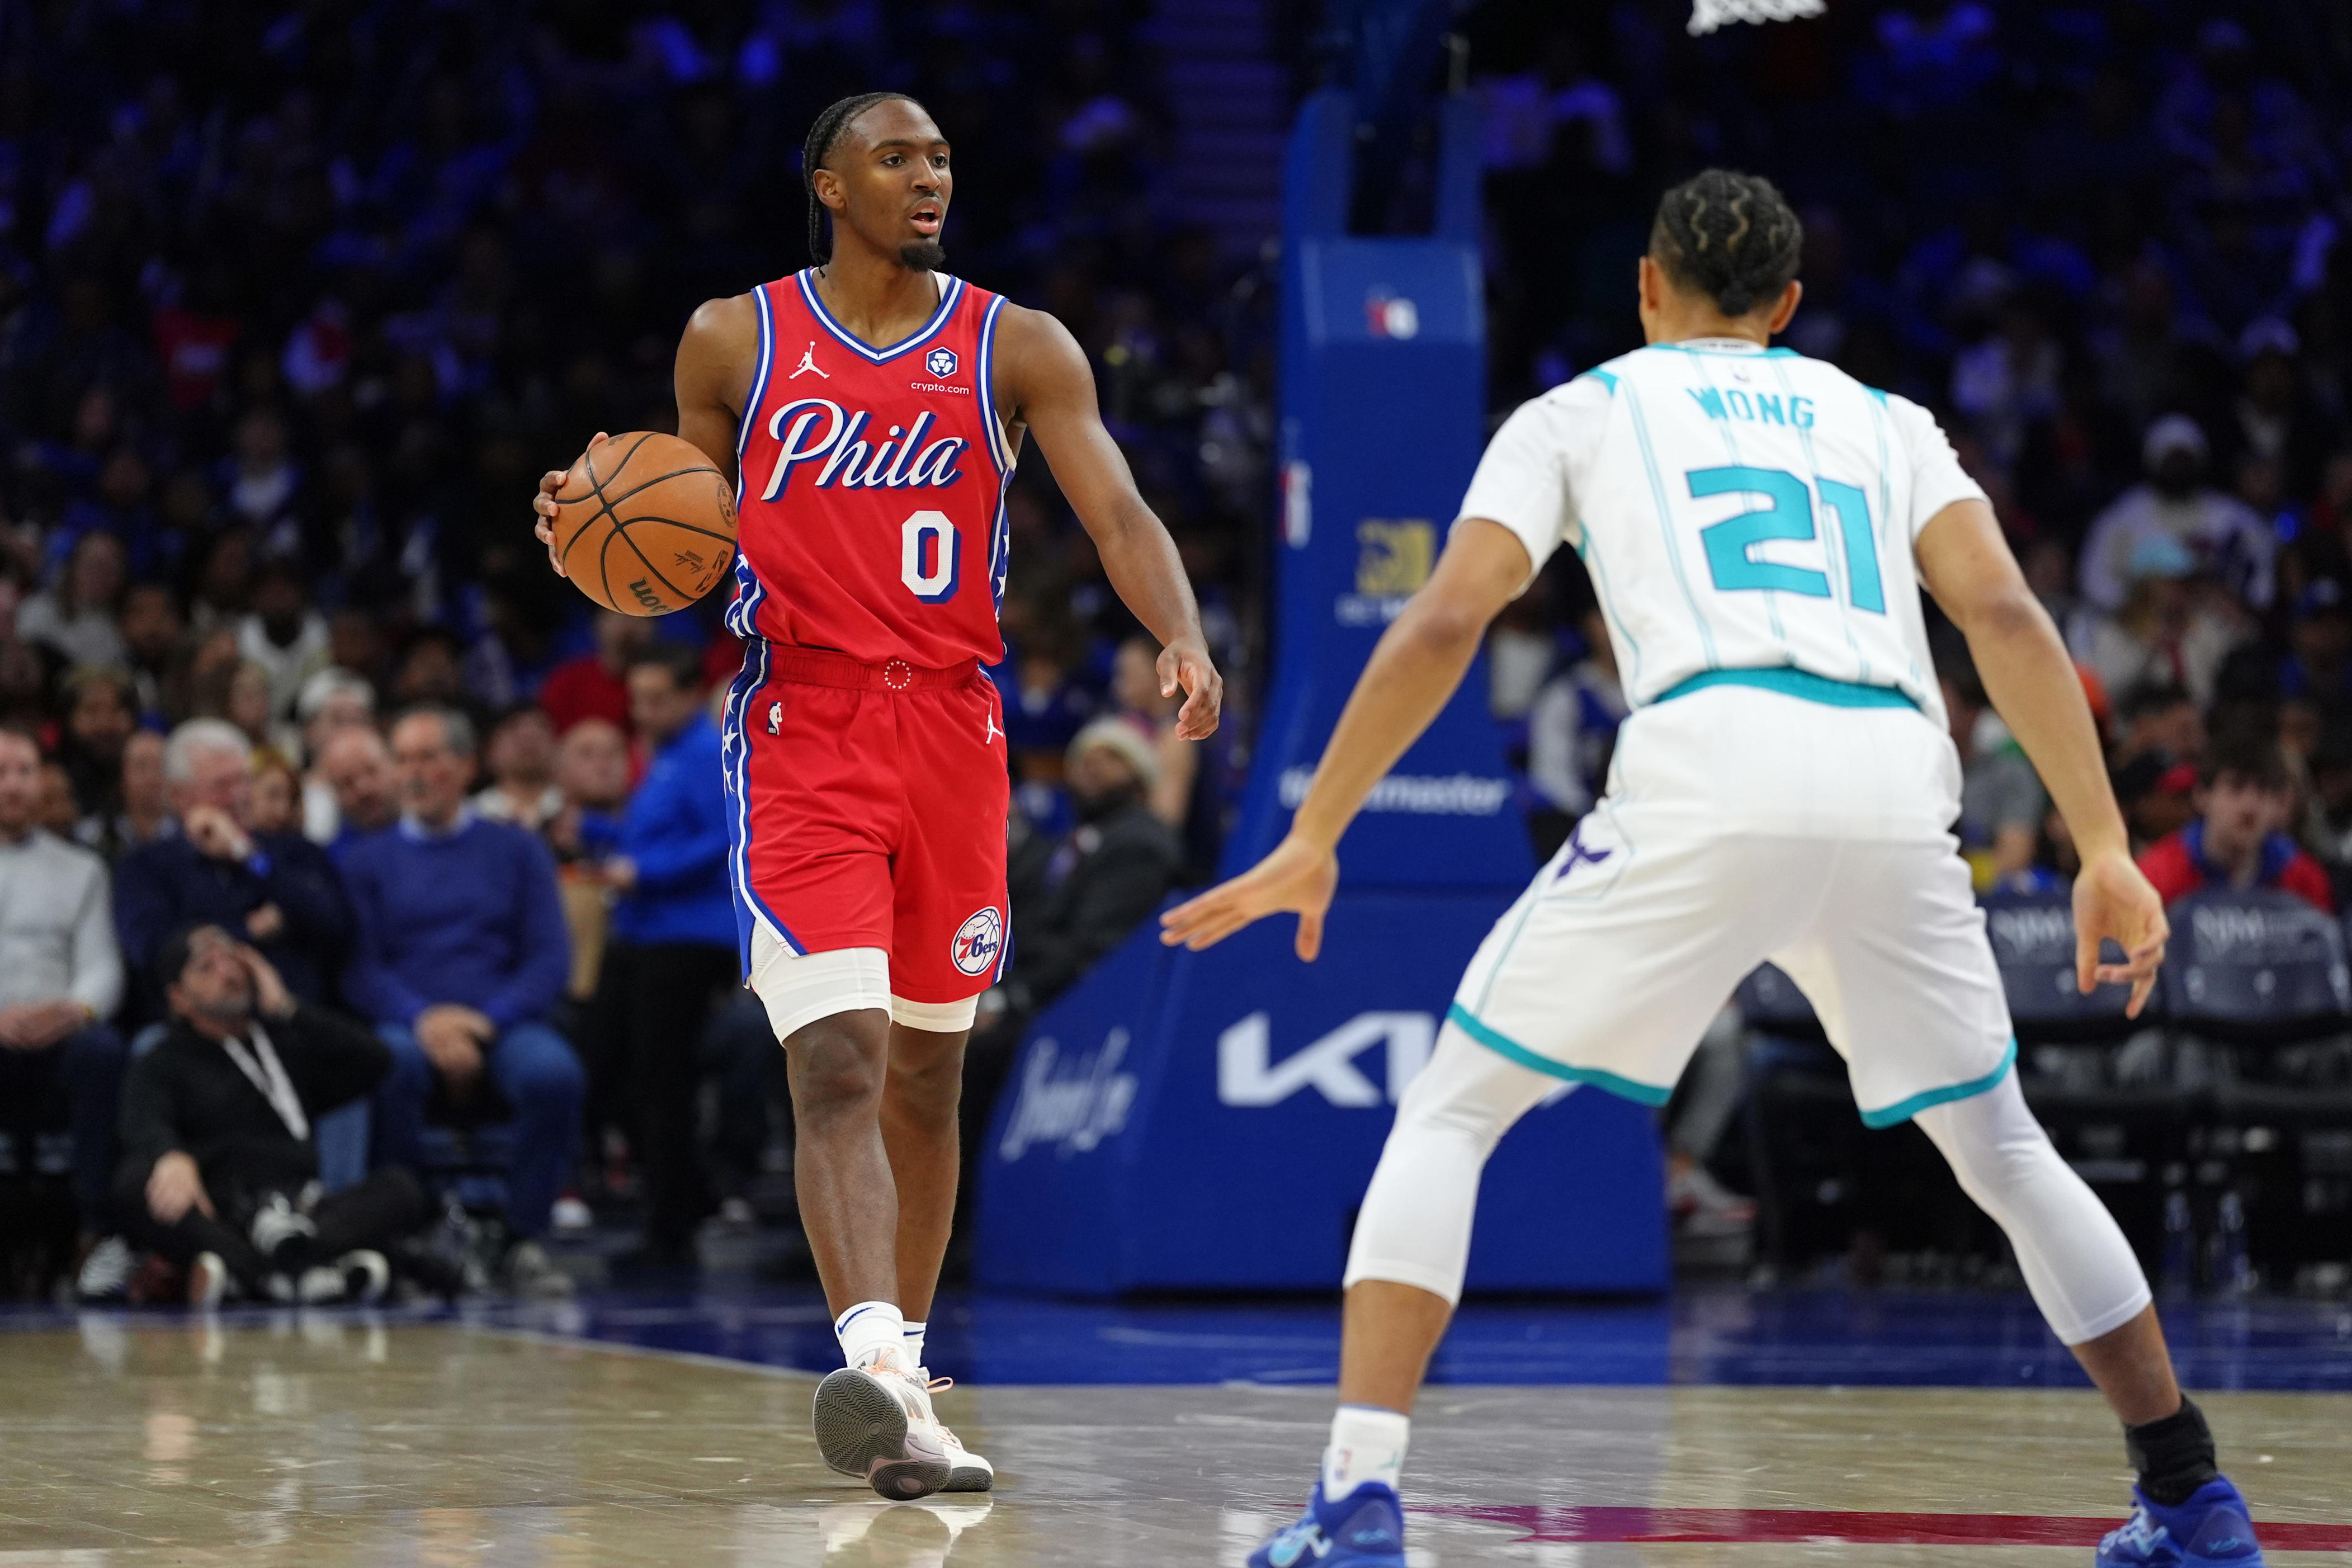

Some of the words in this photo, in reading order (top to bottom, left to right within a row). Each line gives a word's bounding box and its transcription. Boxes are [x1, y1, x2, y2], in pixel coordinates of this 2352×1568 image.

[911, 382, 970, 394] crypto.com
[1687, 388, 1815, 429] WONG
[761, 398, 970, 503] Phila
[901, 510, 961, 604] 0
[1685, 466, 1887, 616] 21
[958, 934, 998, 960] 76ers
